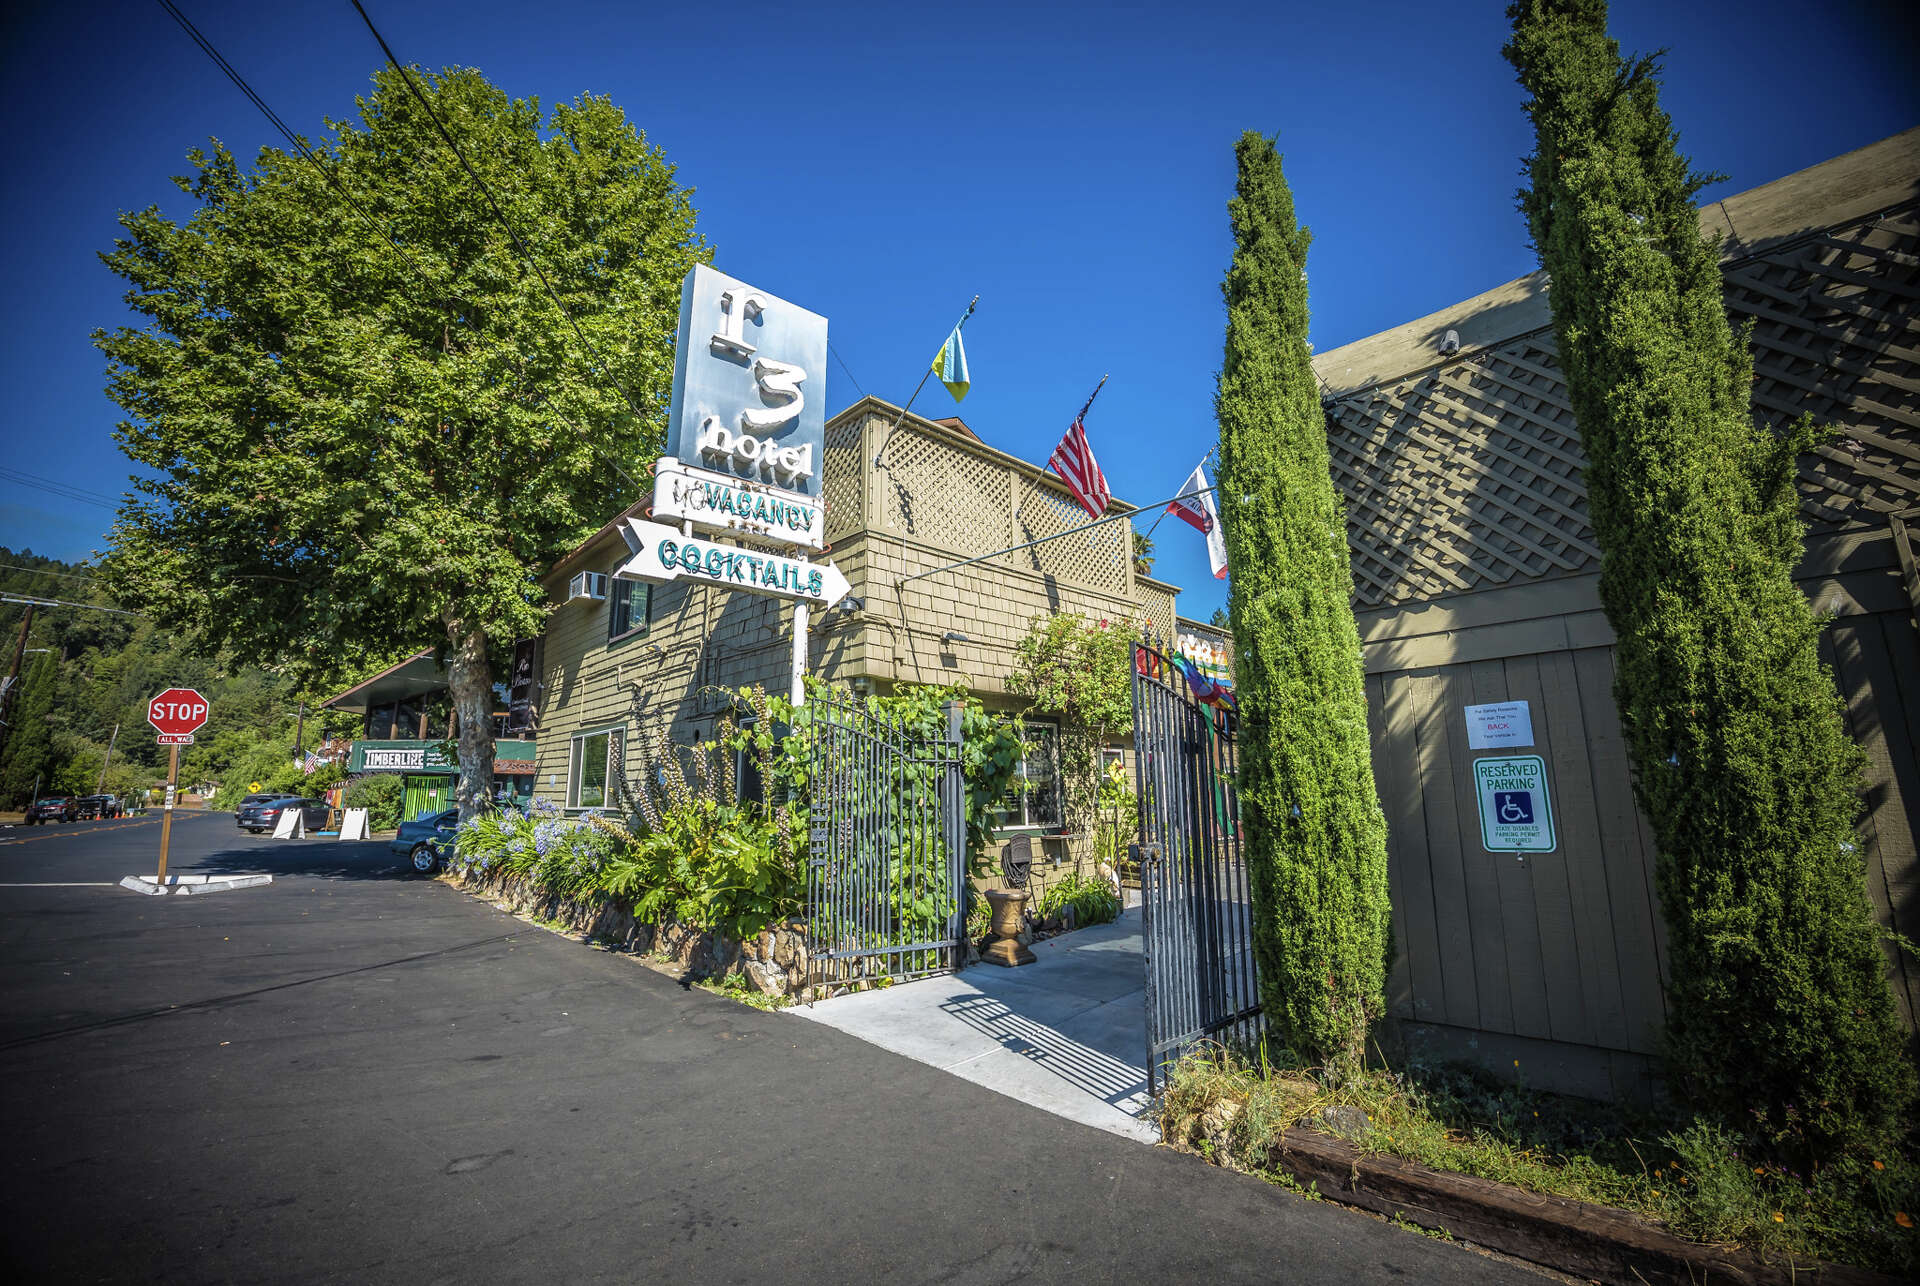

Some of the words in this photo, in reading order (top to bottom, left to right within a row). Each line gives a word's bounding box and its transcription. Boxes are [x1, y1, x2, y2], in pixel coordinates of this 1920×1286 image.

[742, 357, 807, 430] 3
[700, 415, 814, 477] hotel
[704, 482, 816, 532] VACANCY
[658, 539, 823, 597] COCKTAILS
[152, 702, 205, 721] STOP
[1480, 764, 1538, 777] RESERVED
[1487, 778, 1535, 790] PARKING
